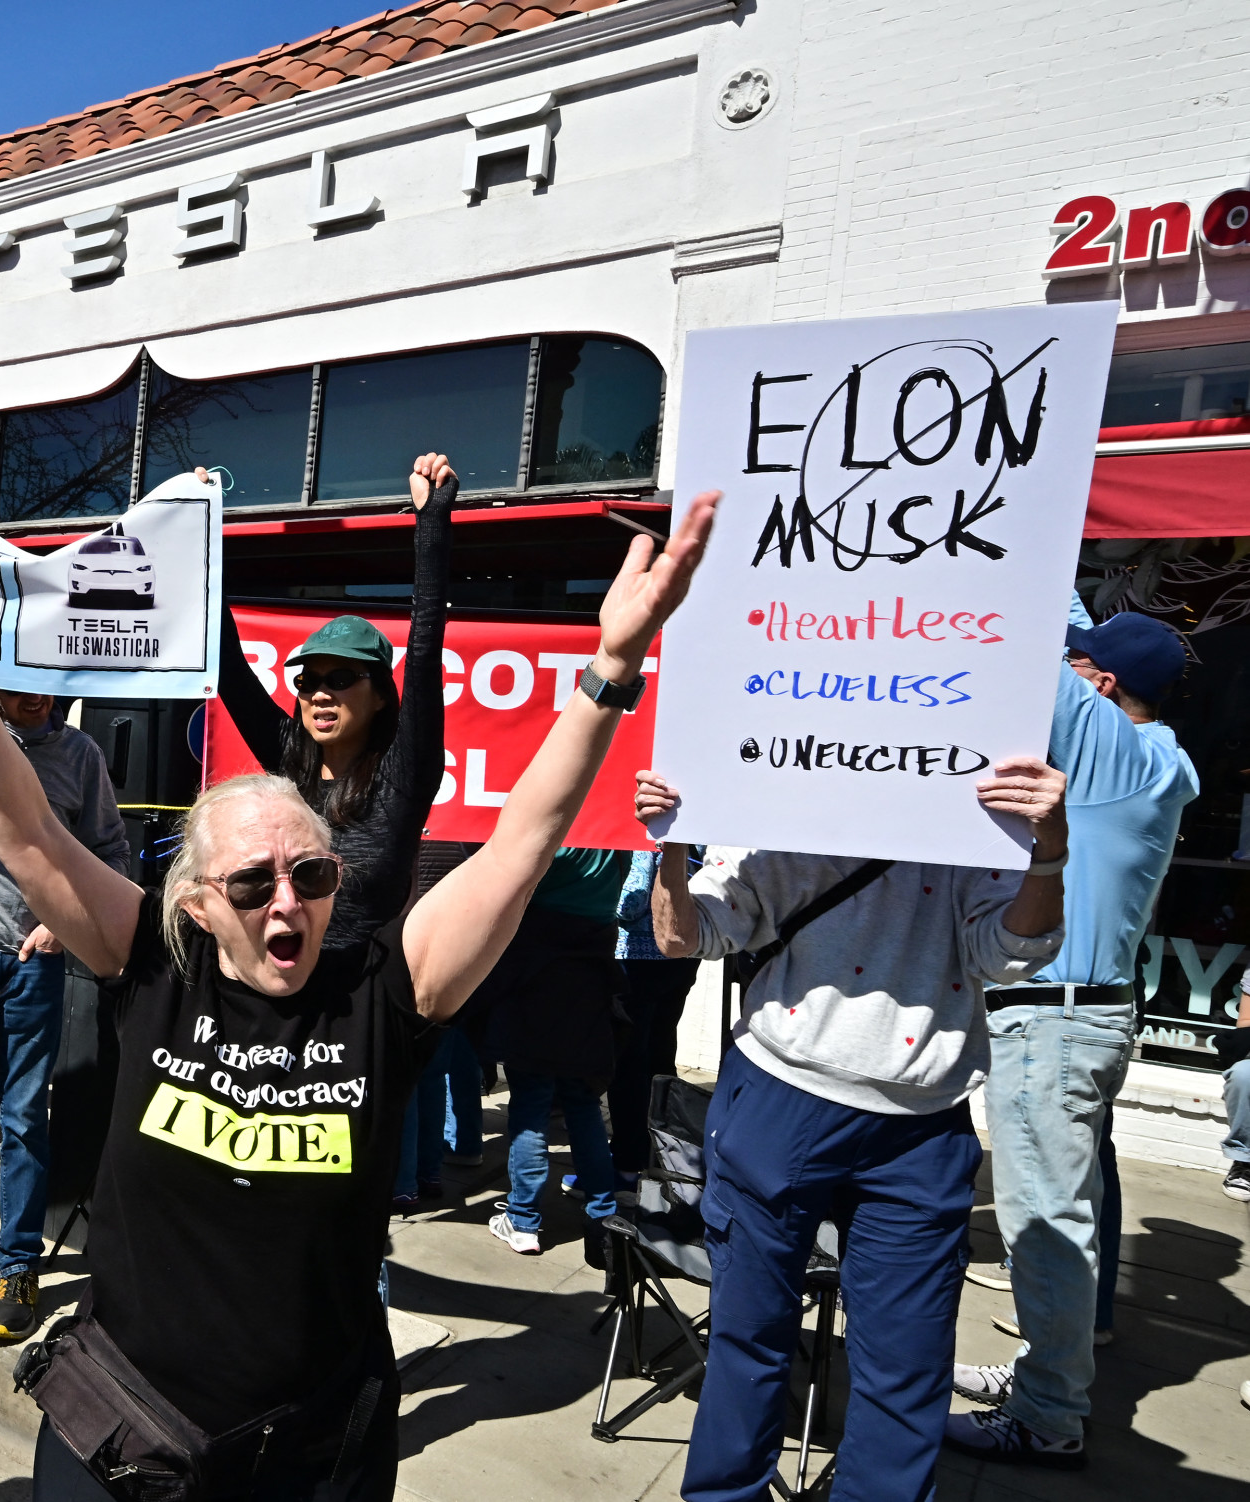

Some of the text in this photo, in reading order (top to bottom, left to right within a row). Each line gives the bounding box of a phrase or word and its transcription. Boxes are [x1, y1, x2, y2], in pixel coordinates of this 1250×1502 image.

[742, 363, 1048, 475] ELON
[751, 489, 1007, 571] MUSK
[67, 618, 149, 634] TESLA
[765, 670, 972, 707] CLUELESS
[769, 734, 991, 777] UNELECTED
[152, 1047, 206, 1082] our
[193, 1015, 248, 1072] Wth
[302, 1039, 346, 1070] for
[158, 1096, 341, 1165] I VOTE.
